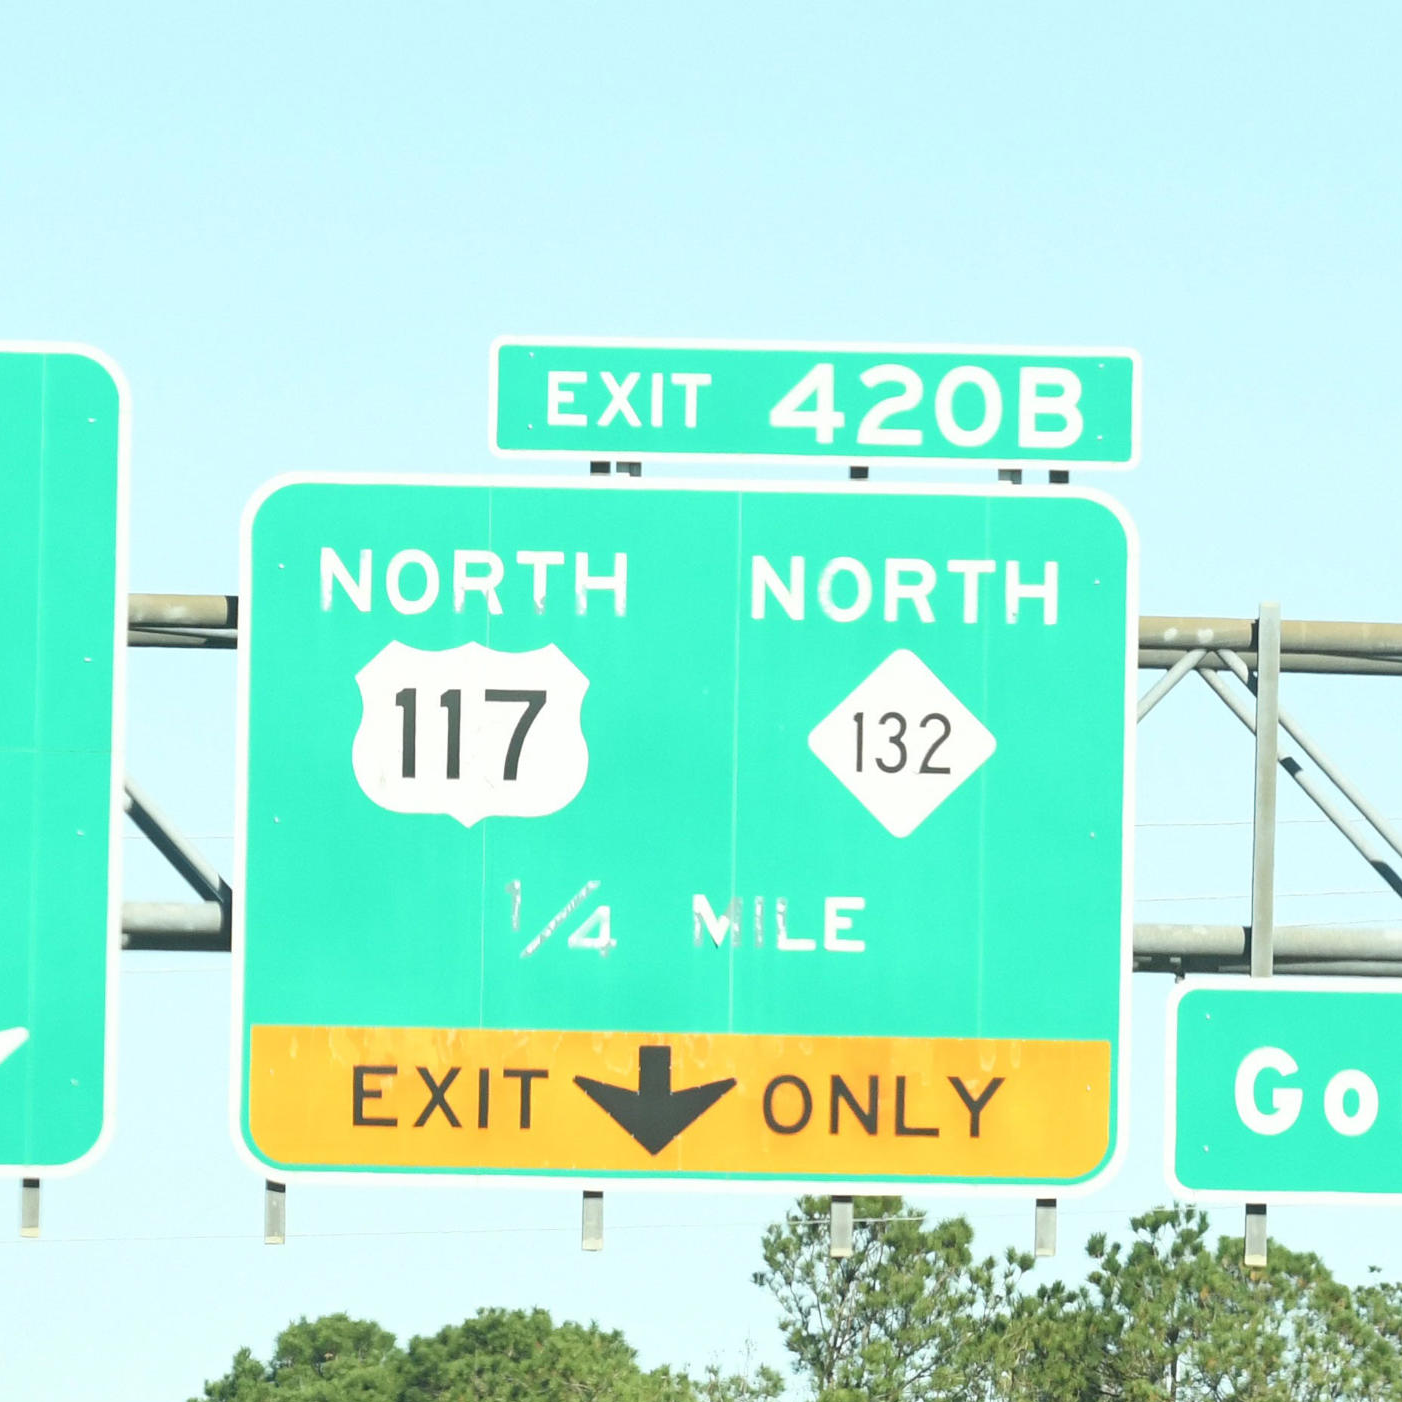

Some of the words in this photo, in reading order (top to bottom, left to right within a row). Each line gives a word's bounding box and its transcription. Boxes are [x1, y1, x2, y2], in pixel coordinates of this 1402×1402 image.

[548, 371, 711, 428] EXIT
[770, 364, 1083, 448] 420B
[321, 548, 627, 616] NORTH
[752, 556, 1058, 625] NORTH
[396, 688, 546, 780] 117
[854, 712, 951, 774] 132
[693, 894, 865, 952] MILE
[353, 1066, 548, 1128] EXIT
[764, 1076, 1002, 1136] ONLY
